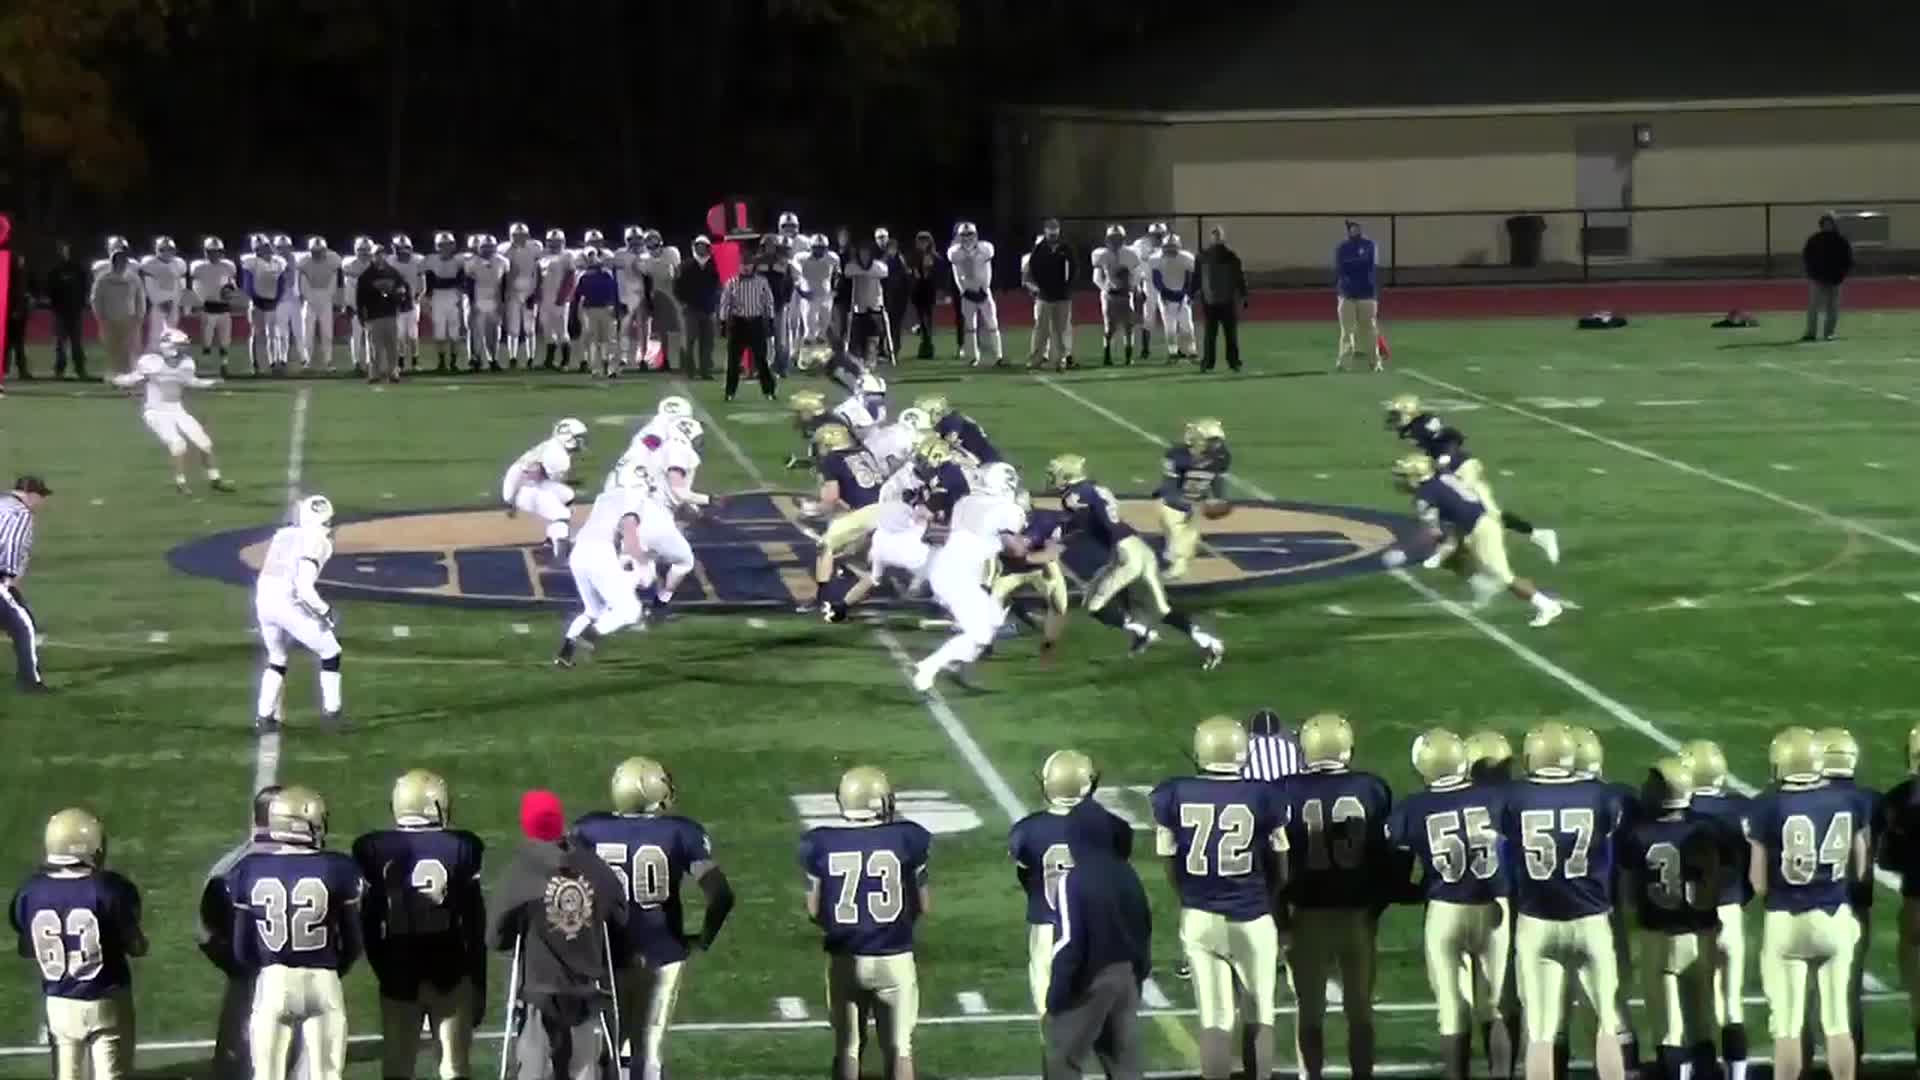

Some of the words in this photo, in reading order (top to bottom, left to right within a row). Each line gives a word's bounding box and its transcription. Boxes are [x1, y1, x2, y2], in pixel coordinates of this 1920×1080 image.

[1180, 803, 1255, 876] 72
[1425, 806, 1497, 883] 55
[1520, 808, 1594, 880] 57
[1781, 811, 1854, 886] 84
[251, 877, 328, 952] 32
[828, 850, 902, 921] 73
[31, 908, 103, 981] 63
